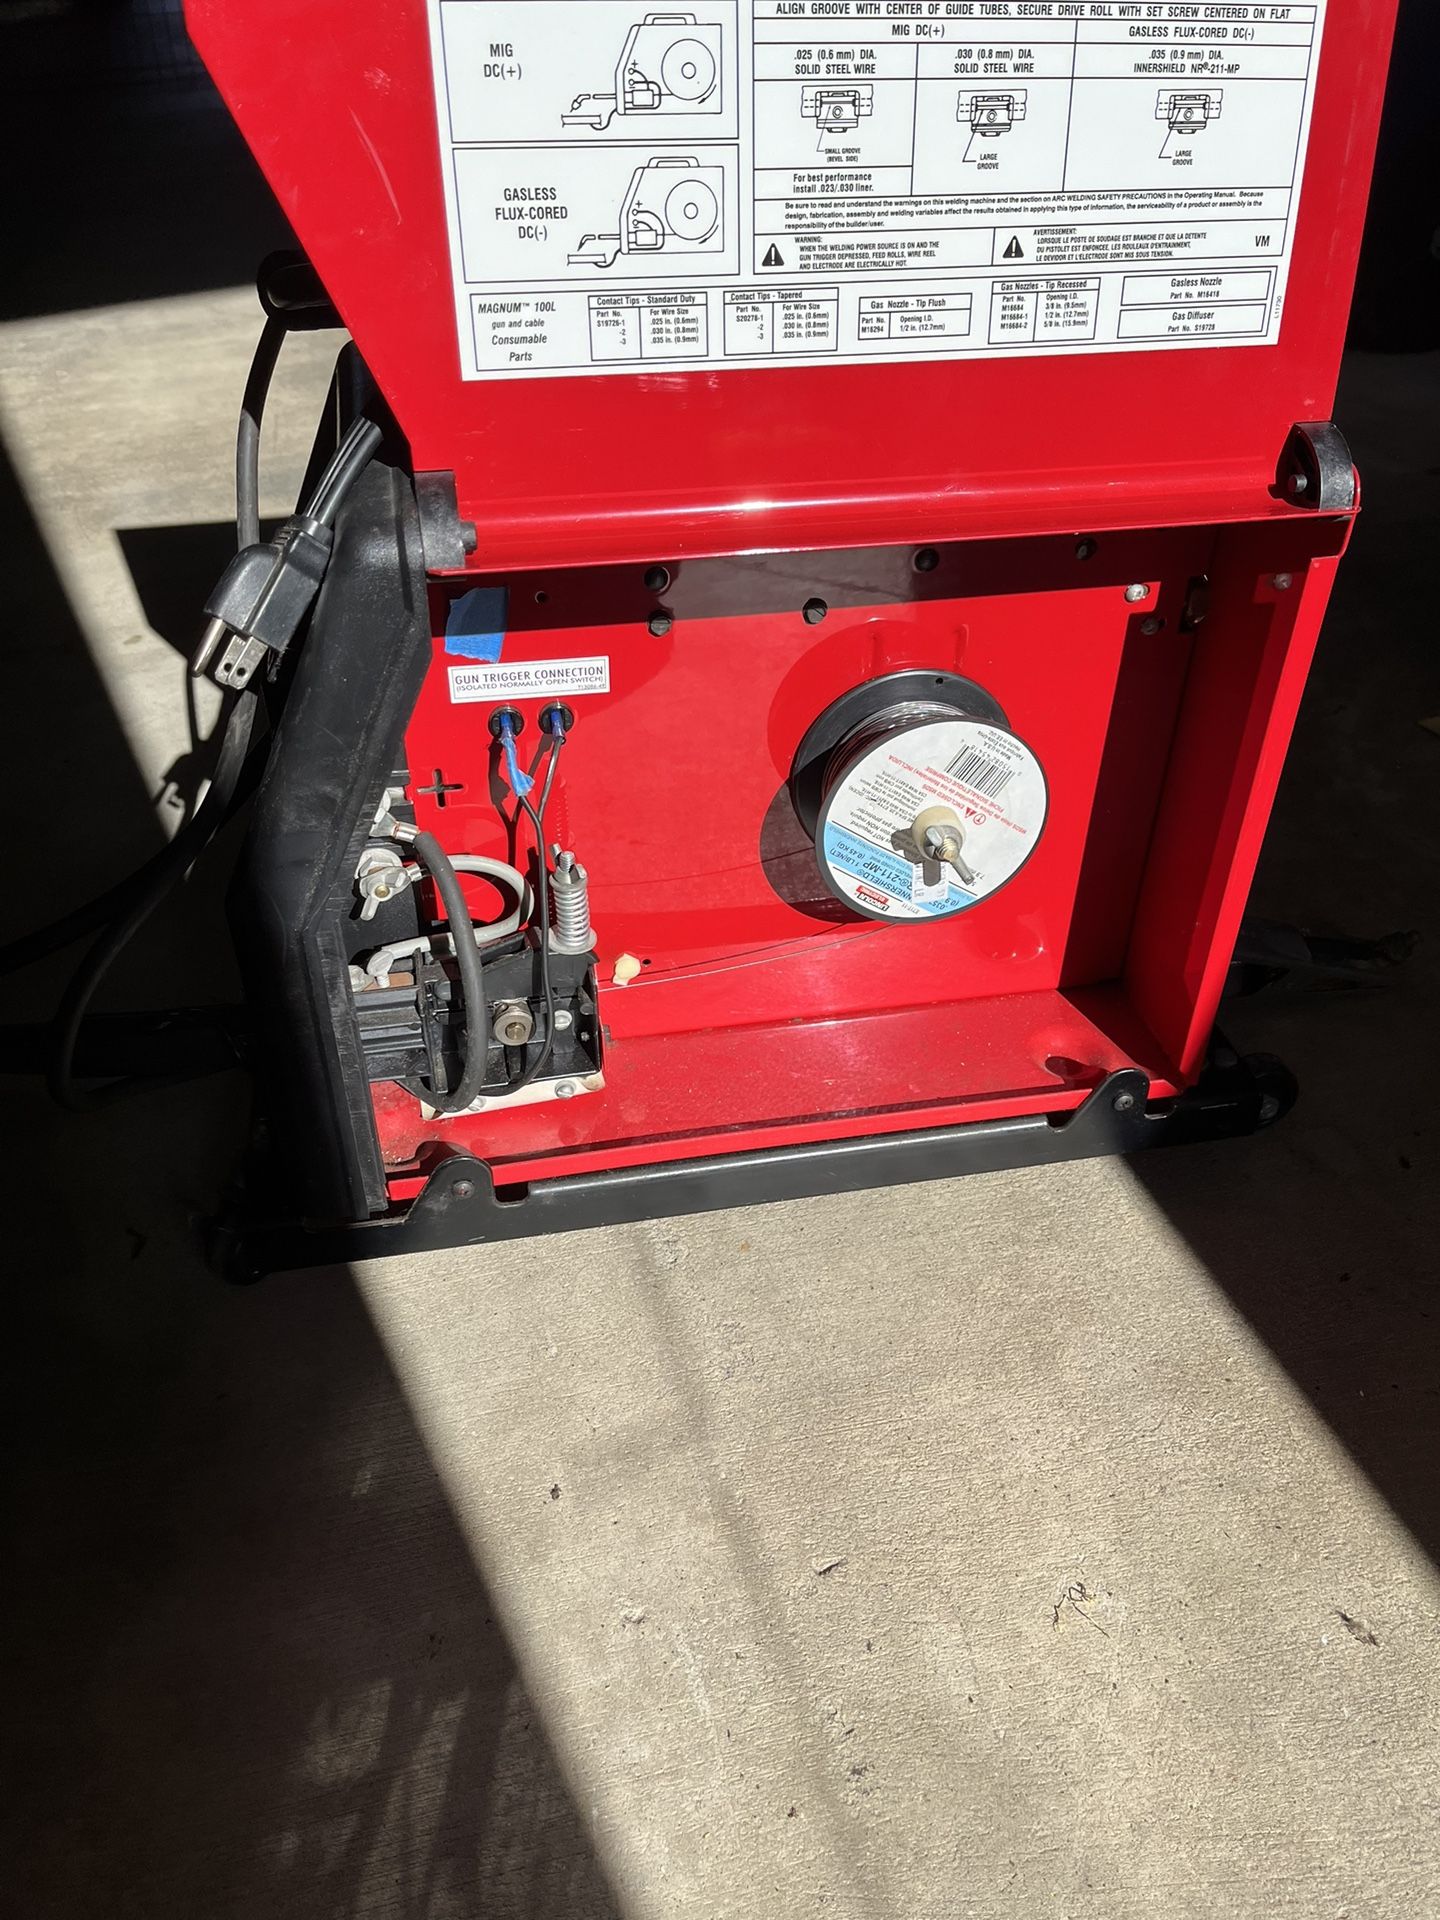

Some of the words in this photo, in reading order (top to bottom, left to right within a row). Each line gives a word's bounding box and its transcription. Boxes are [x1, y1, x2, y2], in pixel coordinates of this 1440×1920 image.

[776, 3, 804, 14] ALIGN
[811, 4, 849, 15] GROOVE
[855, 4, 880, 15] WITH
[886, 4, 922, 15] CENTER
[928, 4, 939, 15] OF
[945, 4, 973, 15] GUIDE
[979, 4, 1011, 15] TUBES,
[1017, 4, 1052, 16] SECURE
[1058, 5, 1084, 16] DRIVE
[1090, 5, 1112, 17] ROLL
[1118, 6, 1141, 17] WITH
[1146, 6, 1162, 17] SET
[1167, 6, 1199, 18] SCREW
[1204, 7, 1248, 19] CENTERED
[1253, 8, 1265, 19] ON
[1270, 8, 1290, 19] FLAT
[892, 25, 909, 37] MIG
[915, 24, 944, 37] DC(+)
[1129, 26, 1168, 38] GASLESS
[1174, 27, 1227, 39] FLUX-CORED
[1232, 28, 1254, 39] DC(-)
[490, 44, 512, 57] MIG
[794, 49, 812, 60] .025
[817, 49, 833, 60] (0.6
[836, 49, 854, 60] mm)
[860, 49, 876, 60] DIA.
[955, 49, 972, 60] .030
[977, 49, 992, 60] (0.8
[995, 49, 1013, 60] mm)
[1018, 49, 1034, 60] DIA.
[1148, 49, 1165, 60] .035
[1170, 49, 1185, 60] (0.9
[1186, 49, 1204, 60] mm)
[1208, 49, 1223, 60] DIA.
[483, 64, 521, 80] DC(+)
[795, 64, 820, 74] SOLID
[825, 64, 850, 74] STEEL
[853, 64, 875, 74] WIRE
[954, 63, 978, 74] SOLID
[983, 63, 1007, 73] STEEL
[1013, 63, 1033, 73] WIRE
[977, 162, 998, 170] GROOVE
[1172, 158, 1192, 166] GROOVE
[793, 173, 805, 183] For
[807, 173, 822, 183] best
[824, 172, 871, 183] performance
[503, 187, 556, 201] GASLESS
[793, 184, 816, 193] install
[818, 184, 853, 193] .023/.030
[855, 184, 873, 193] liner.
[785, 202, 793, 210] Be
[795, 201, 809, 210] sure
[810, 201, 816, 209] to
[818, 200, 832, 209] read
[833, 200, 845, 208] and
[846, 199, 881, 208] understand
[882, 199, 892, 207] the
[894, 198, 922, 207] warnings
[923, 198, 931, 206] on
[932, 198, 943, 206] this
[945, 197, 968, 206] welding
[970, 196, 996, 205] machine
[999, 196, 1008, 204] and
[1009, 196, 1018, 204] the
[1020, 195, 1042, 204] section
[1043, 195, 1051, 203] on
[1051, 194, 1065, 203] ARC
[1066, 194, 1096, 202] WELDING
[1097, 193, 1121, 202] SAFETY
[1121, 192, 1166, 201] PRECAUTIONS
[1167, 192, 1172, 200] in
[1174, 192, 1182, 200] the
[1184, 191, 1212, 200] Operating
[1214, 190, 1235, 199] Manual.
[1239, 190, 1263, 198] Because
[495, 206, 567, 220] FLUX-CORED
[518, 225, 547, 240] DC(-)
[1255, 236, 1269, 247] VM
[1000, 282, 1012, 291] Gas
[1014, 282, 1038, 291] Nozzles
[1046, 281, 1055, 290] Tip
[1056, 280, 1087, 289] Recessed
[1170, 277, 1198, 287] Gasless
[1199, 277, 1222, 286] Nozzle
[596, 296, 623, 306] Contact
[625, 296, 639, 305] Tips
[647, 295, 677, 305] Standard
[680, 295, 695, 304] Duty
[730, 292, 755, 301] Contact
[757, 292, 770, 300] Tips
[777, 291, 802, 300] Tapered
[870, 300, 883, 309] Gas
[887, 300, 908, 309] Nozzle
[916, 299, 926, 308] Tip
[928, 298, 945, 307] Flush
[1172, 311, 1185, 320] Gas
[1186, 310, 1214, 320] Diffuser
[491, 319, 505, 329] gun
[508, 319, 522, 328] and
[524, 318, 544, 328] cable
[491, 334, 547, 345] Consumable
[509, 352, 532, 362] Parts
[454, 674, 478, 684] GUN
[482, 670, 530, 682] TRIGGER
[534, 666, 605, 679] CONNECTION
[456, 682, 497, 692] (ISOLATED
[499, 679, 543, 689] NORMALLY
[545, 678, 568, 686] OPEN
[570, 675, 605, 684] SWITCH)
